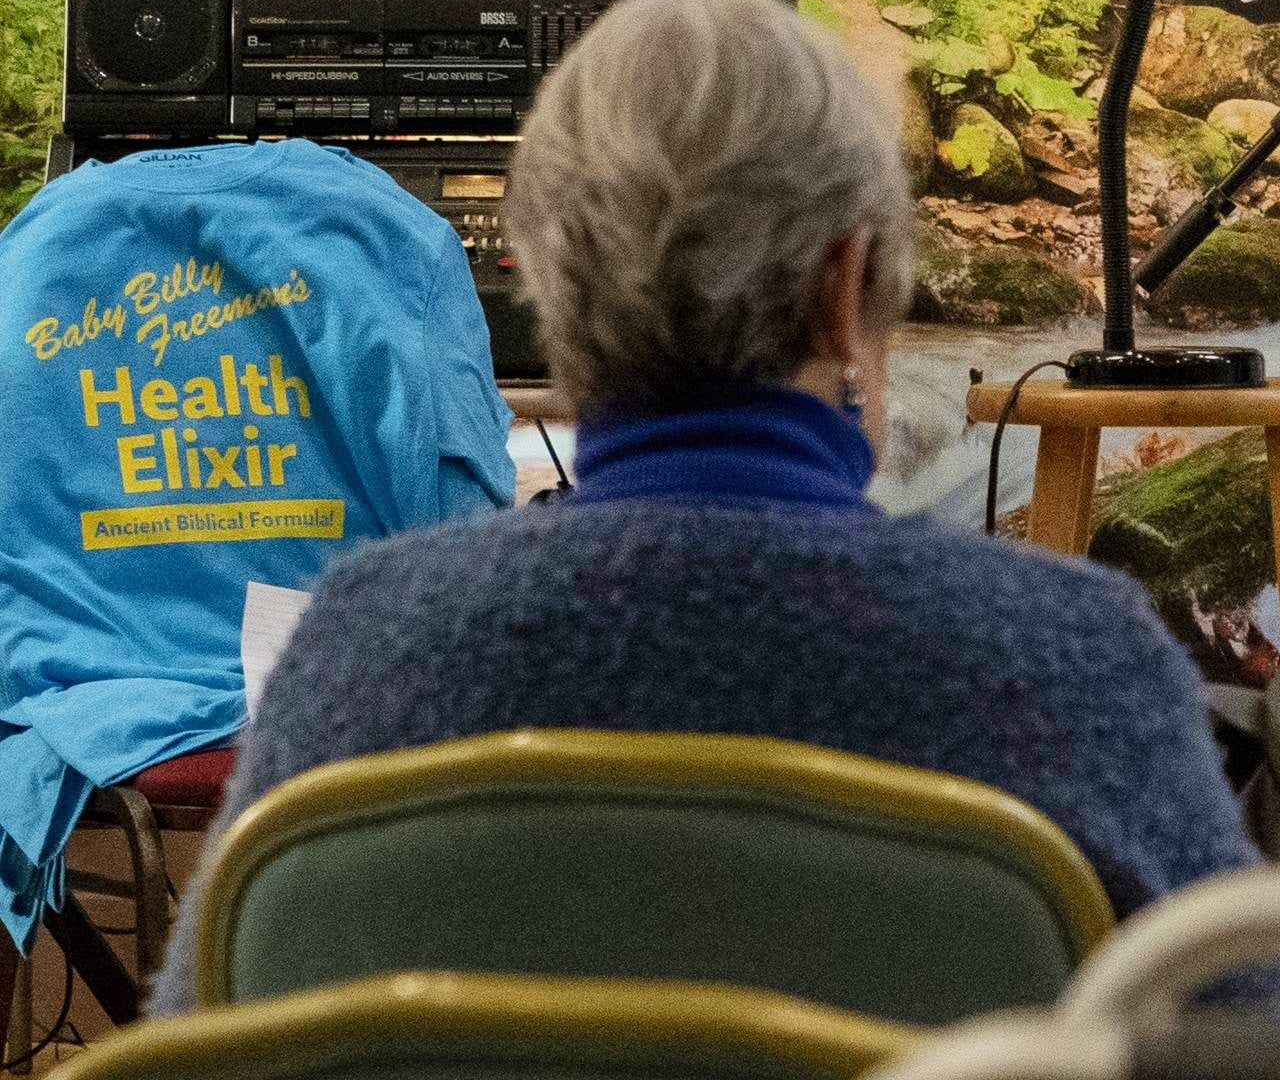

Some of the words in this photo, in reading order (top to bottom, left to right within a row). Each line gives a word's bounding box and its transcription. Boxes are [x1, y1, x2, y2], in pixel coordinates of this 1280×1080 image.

[247, 35, 258, 47] B
[498, 37, 511, 49] A
[271, 71, 315, 80] HI-SPEED
[316, 71, 359, 80] DUBBING
[426, 72, 449, 81] AUTO
[450, 72, 483, 81] REVERSE
[140, 153, 202, 163] GILDAN
[25, 296, 127, 361] Baby
[124, 255, 224, 316] Billy
[136, 269, 311, 367] Freeman's
[79, 353, 312, 428] Health
[117, 425, 298, 495] Elixir
[93, 516, 172, 539] Ancient
[175, 513, 245, 532] Biblical
[249, 507, 336, 528] Formula!
